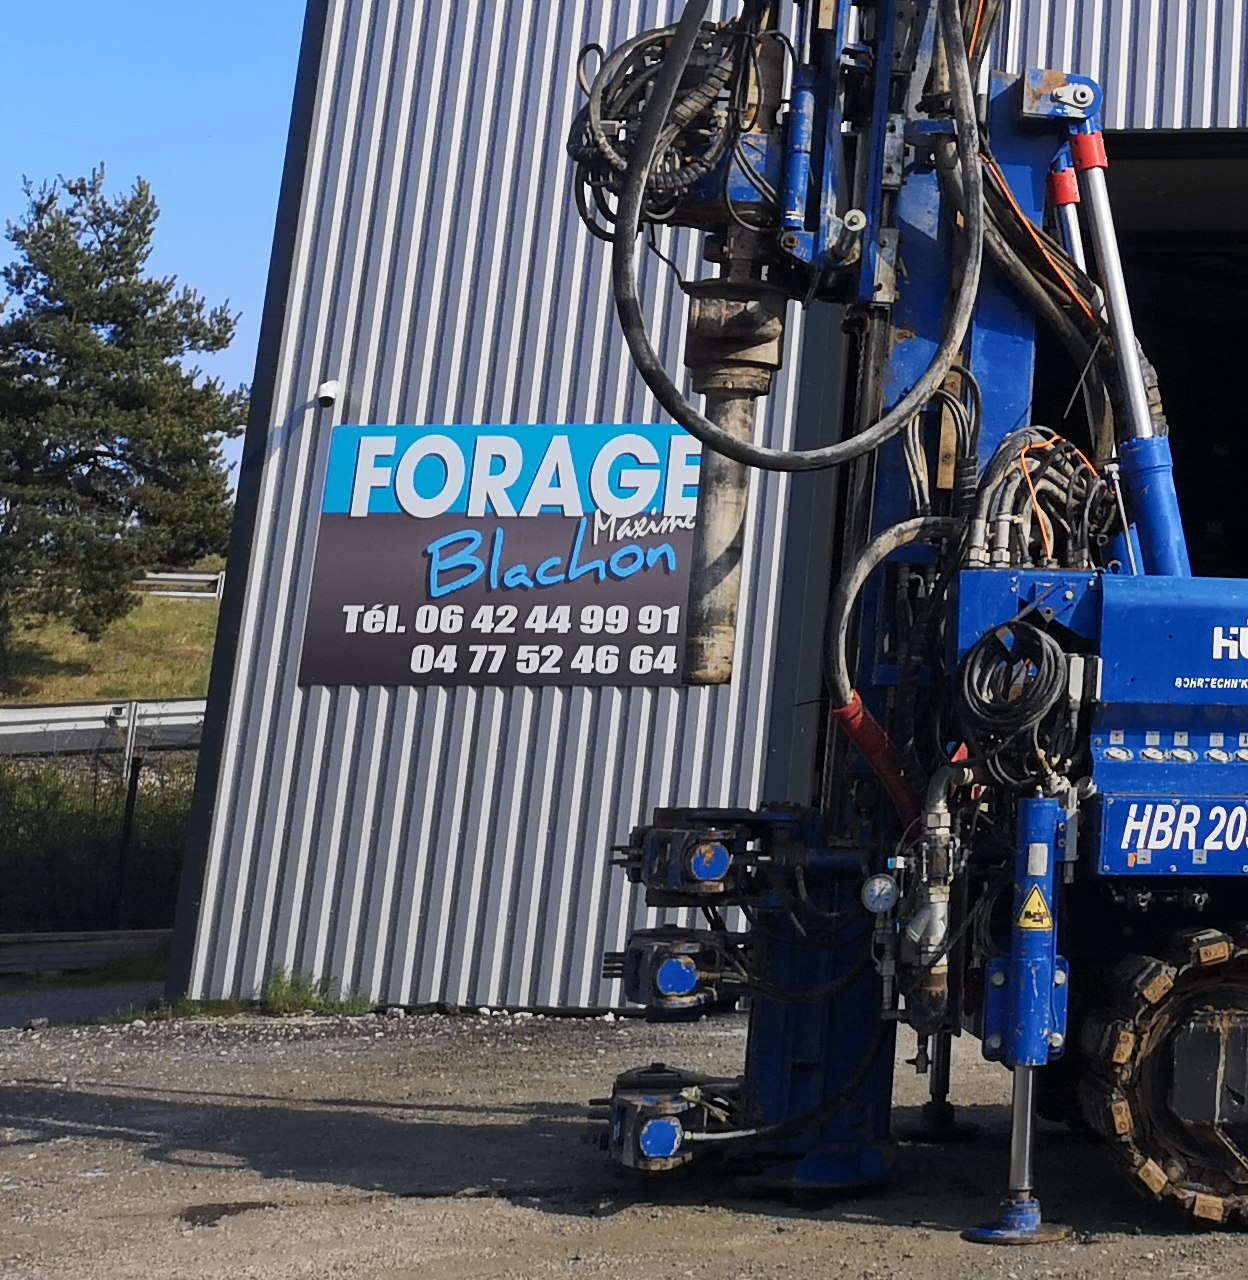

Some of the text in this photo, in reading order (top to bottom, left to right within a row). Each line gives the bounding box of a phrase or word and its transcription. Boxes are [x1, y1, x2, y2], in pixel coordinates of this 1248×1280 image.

[350, 433, 702, 518] FORAGE
[593, 507, 697, 545] Maxime
[426, 517, 677, 598] Blachon
[342, 604, 680, 634] Tél. 06 42 44 99 91
[410, 644, 678, 674] 04 77 52 46 64
[1121, 804, 1200, 850] HBR
